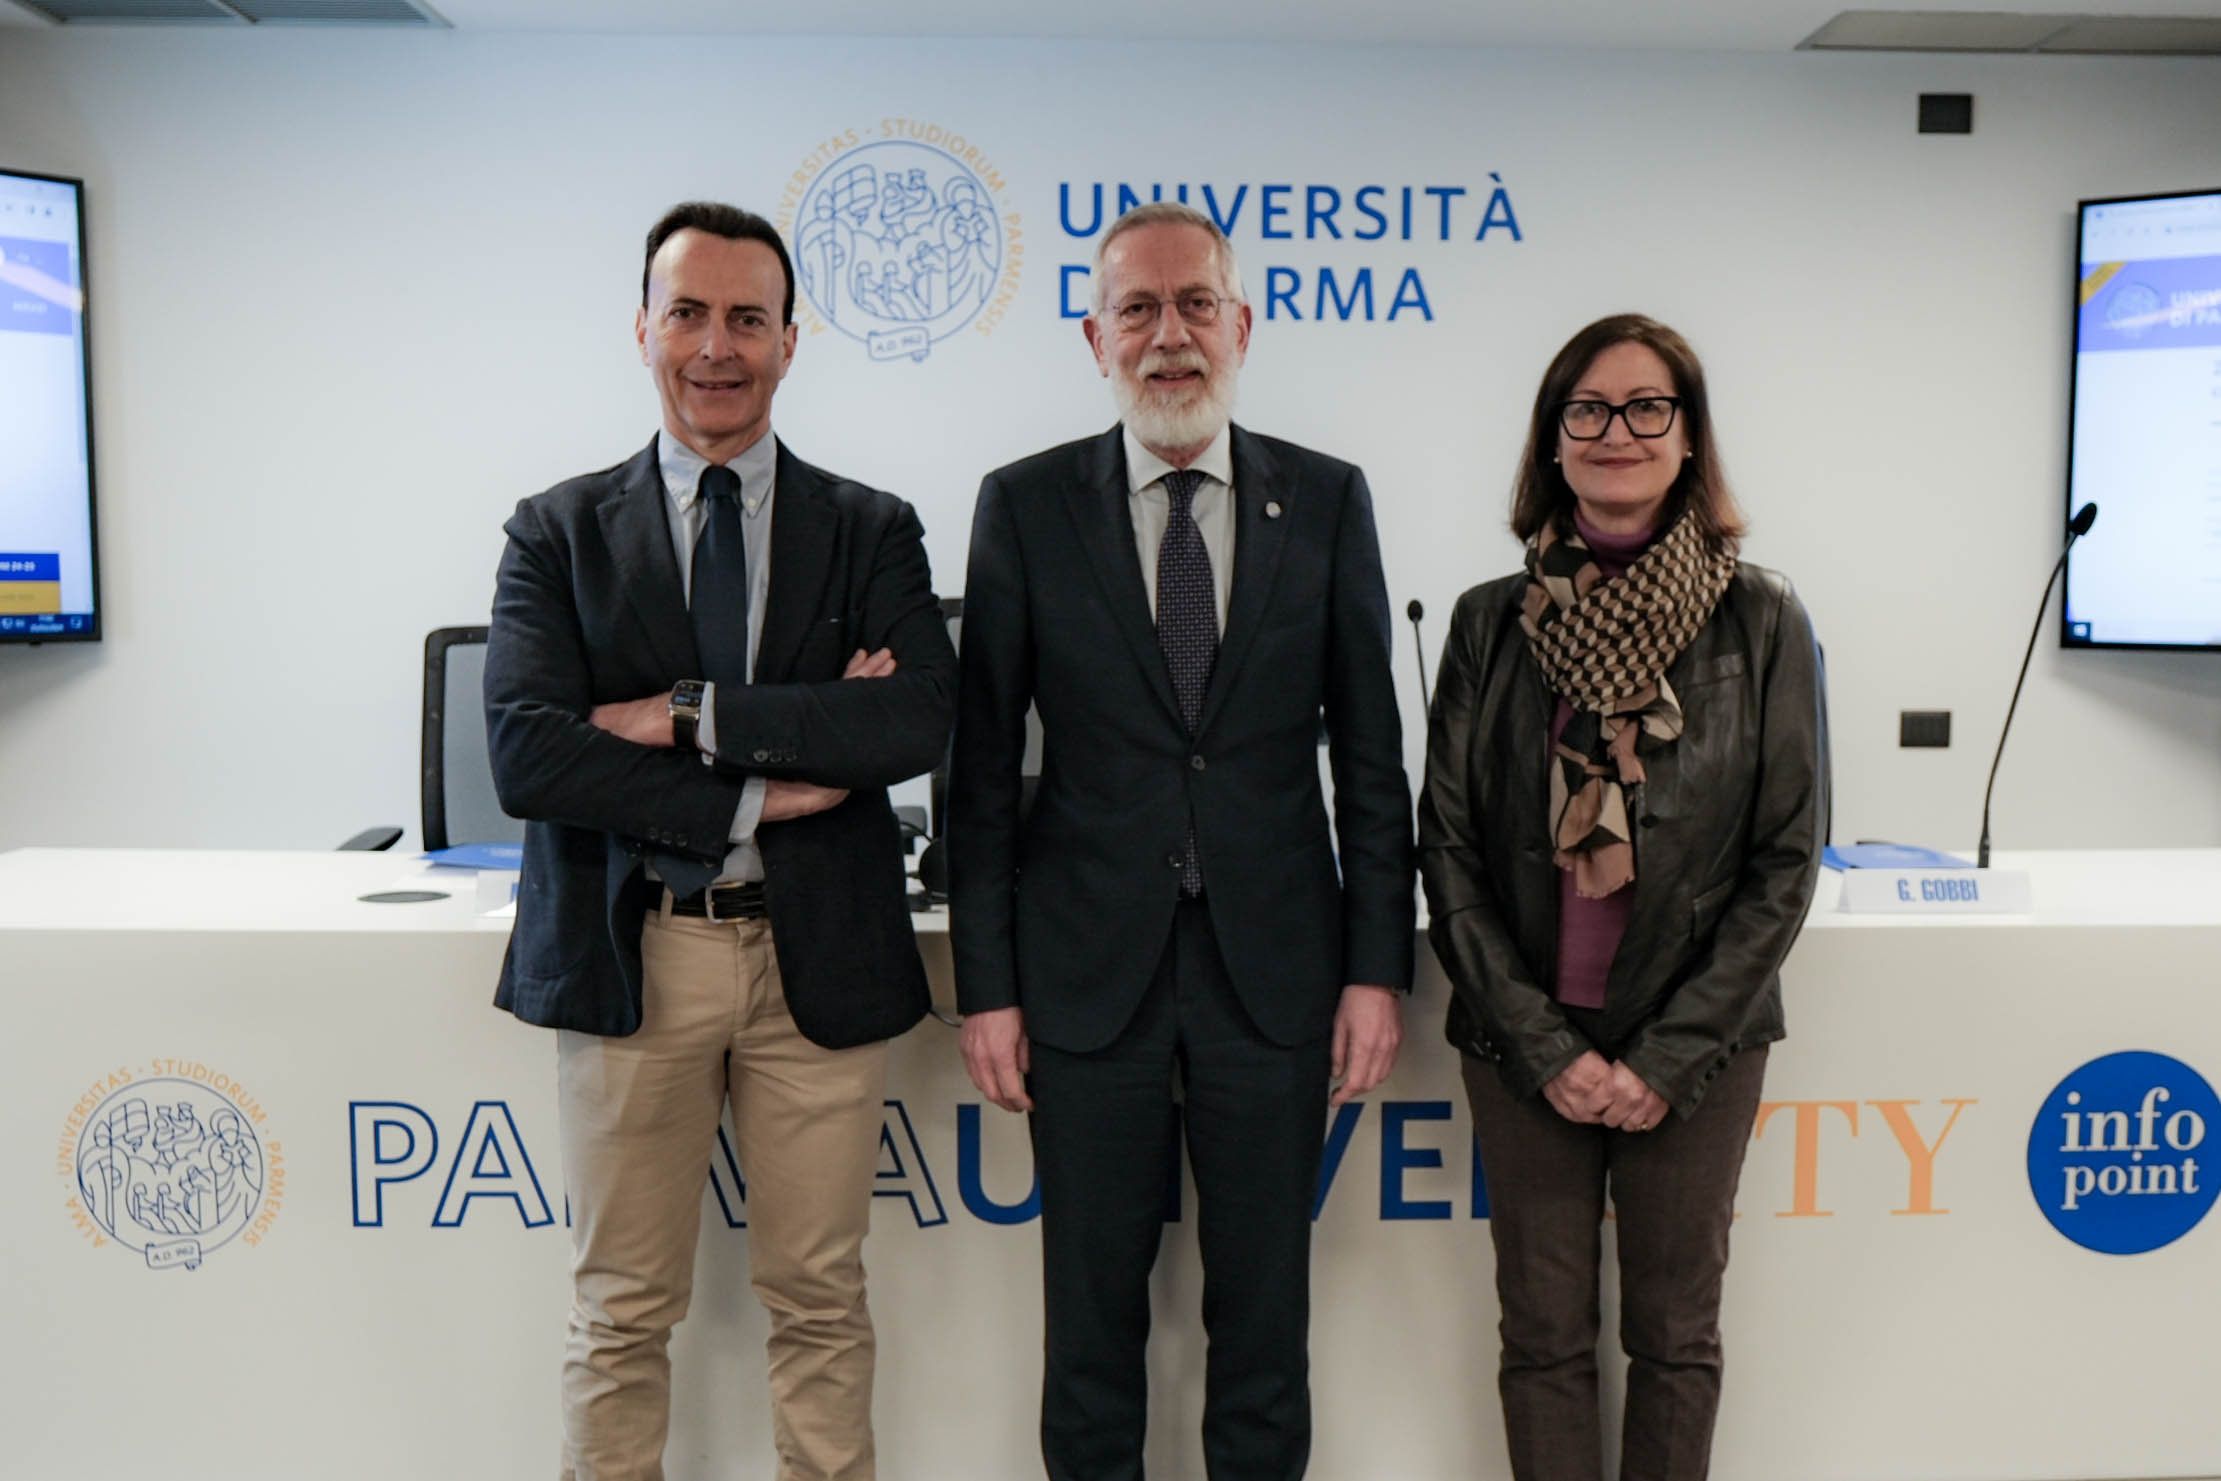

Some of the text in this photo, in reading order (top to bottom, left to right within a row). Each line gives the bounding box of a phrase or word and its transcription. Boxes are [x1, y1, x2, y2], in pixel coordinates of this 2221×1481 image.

[881, 118, 1006, 193] STUDIORUM
[976, 214, 1024, 337] PARMENSIS
[1243, 265, 1434, 322] RMA
[1897, 878, 1980, 902] G. GOBBI
[2059, 1086, 2206, 1152] info
[57, 1058, 286, 1248] ALMA UNIVERSITAS STUDIORUM PARMENSIS
[2060, 1151, 2200, 1211] point
